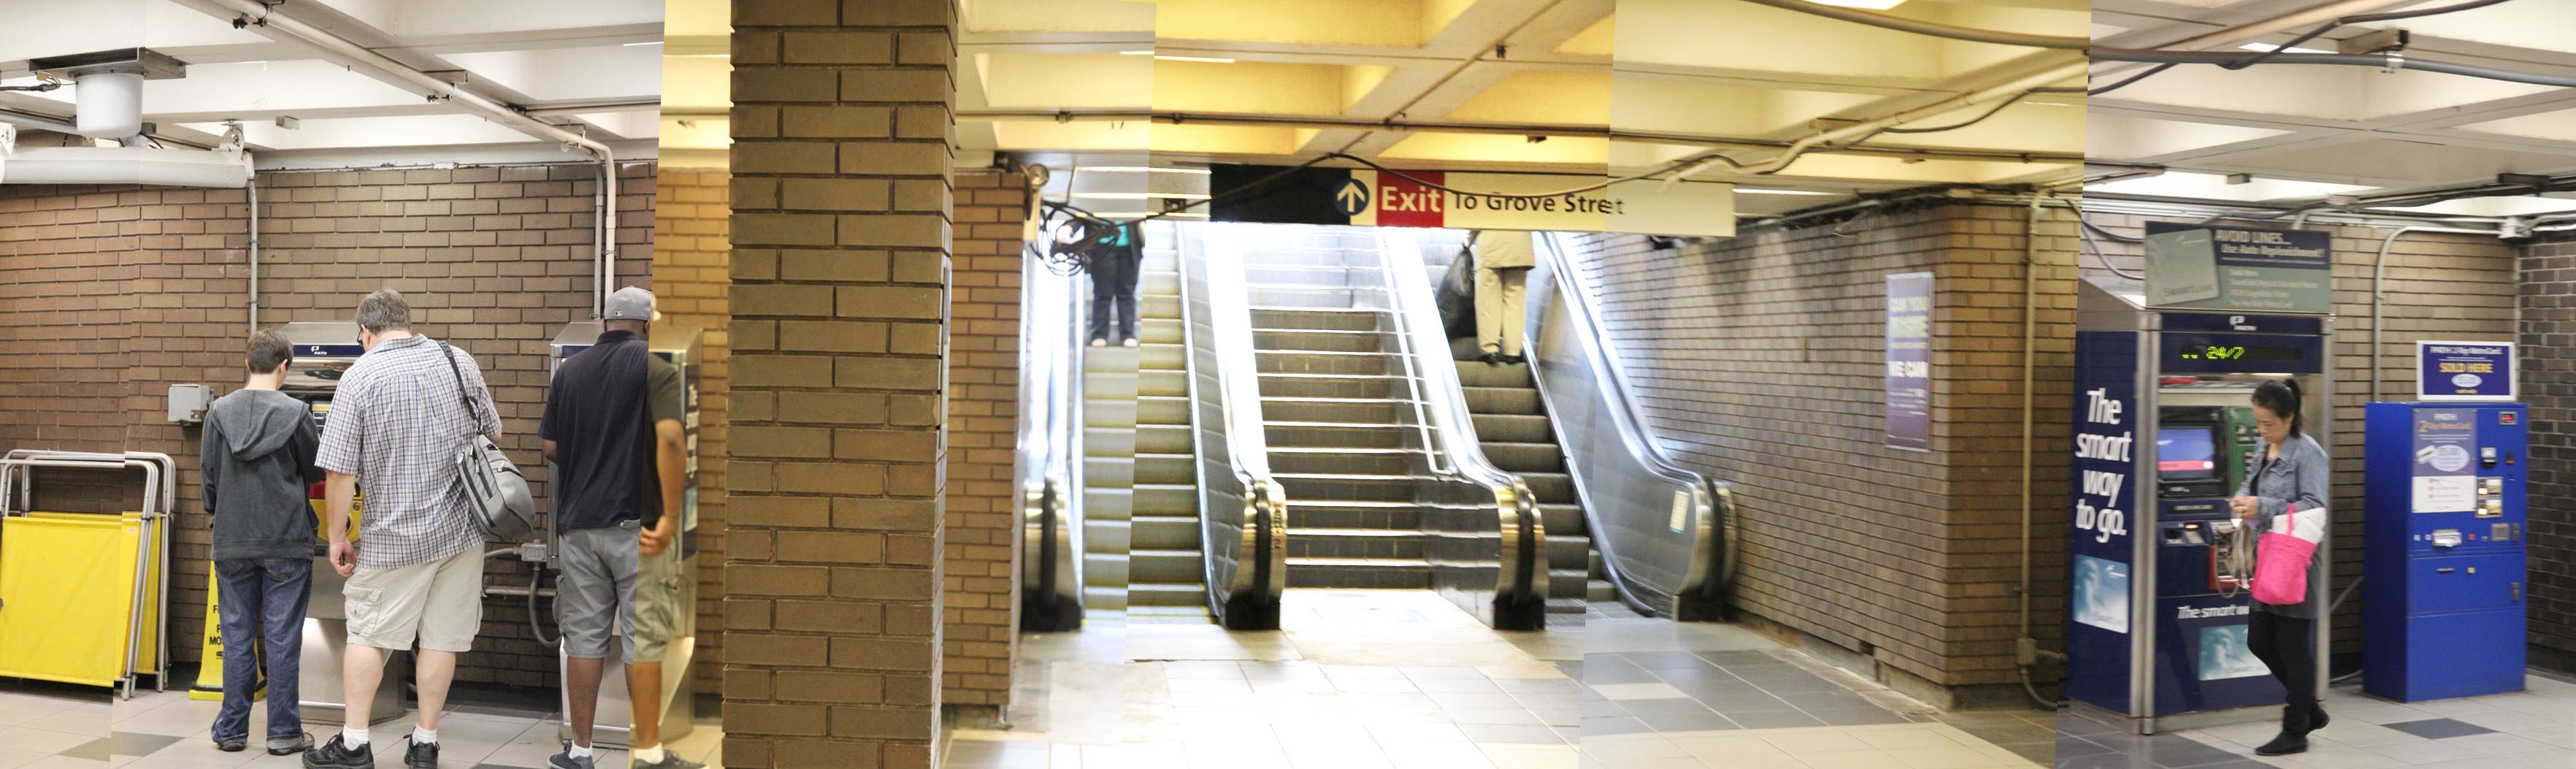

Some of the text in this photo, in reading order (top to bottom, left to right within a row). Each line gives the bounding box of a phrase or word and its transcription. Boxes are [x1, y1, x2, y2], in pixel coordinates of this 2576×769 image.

[1381, 185, 1441, 213] Exit
[1453, 191, 1477, 210] To
[1487, 191, 1556, 211] Grove
[2215, 229, 2251, 242] AVOID
[2207, 346, 2245, 359] 24/7
[2086, 388, 2123, 425] The
[2075, 431, 2133, 462] smart
[2082, 470, 2125, 508] way
[2075, 499, 2128, 543] to go.
